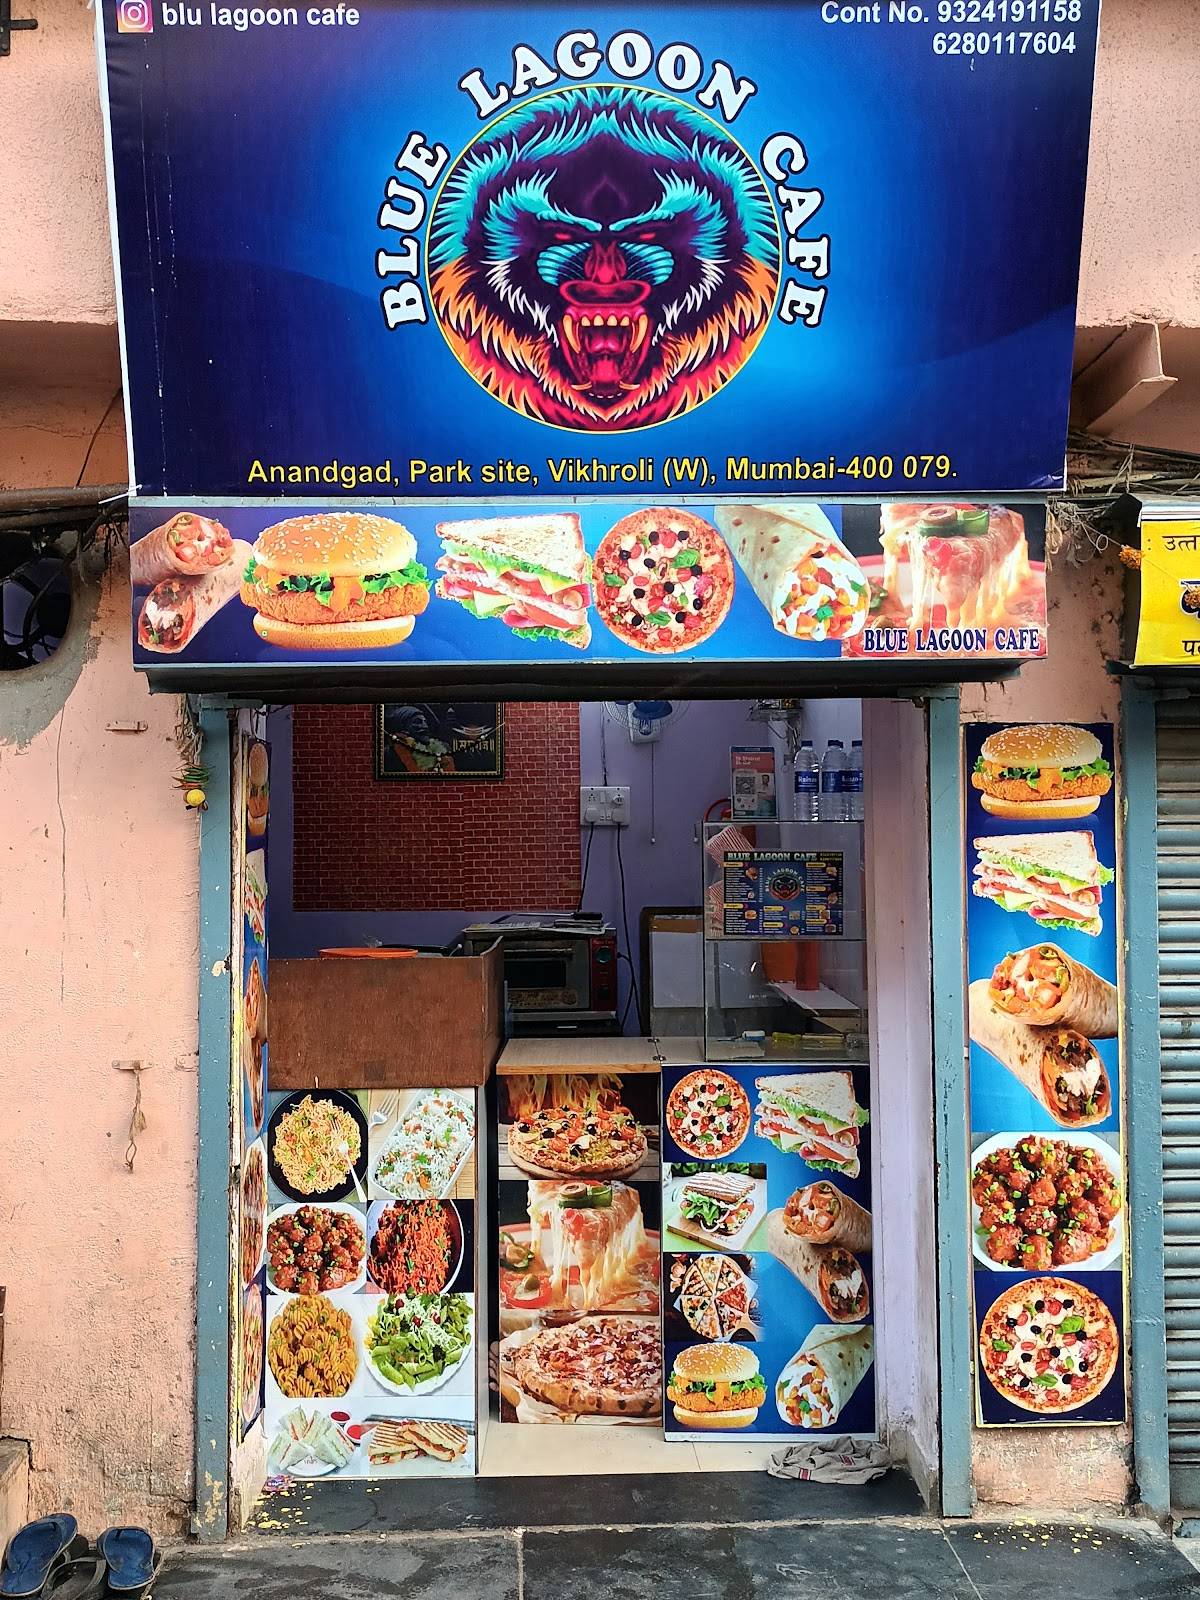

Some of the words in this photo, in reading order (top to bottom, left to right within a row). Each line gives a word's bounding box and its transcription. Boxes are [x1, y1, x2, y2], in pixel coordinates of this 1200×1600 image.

[161, 2, 202, 26] blu
[210, 2, 298, 32] lagoon
[306, 2, 360, 26] cafe
[821, 0, 881, 24] Cont
[887, 0, 930, 24] No.
[936, 0, 1083, 23] 9324191158
[931, 31, 1078, 55] 6280117604
[377, 133, 449, 330] BLUE
[459, 31, 757, 122] LAGOON
[761, 134, 829, 327] CAFE
[247, 460, 400, 489] Anandgad,
[408, 460, 473, 482] Park
[480, 461, 538, 486] site,
[547, 459, 655, 483] Vikhroli
[662, 457, 717, 485] (W),
[725, 456, 893, 482] Mumbai-400
[902, 455, 959, 479] 079.
[863, 628, 909, 652] BLUE
[915, 628, 987, 652] LAGOON
[993, 628, 1041, 652] CAFE
[727, 852, 751, 861] BLUE
[753, 852, 791, 861] LAGOON
[793, 852, 818, 861] CAFE
